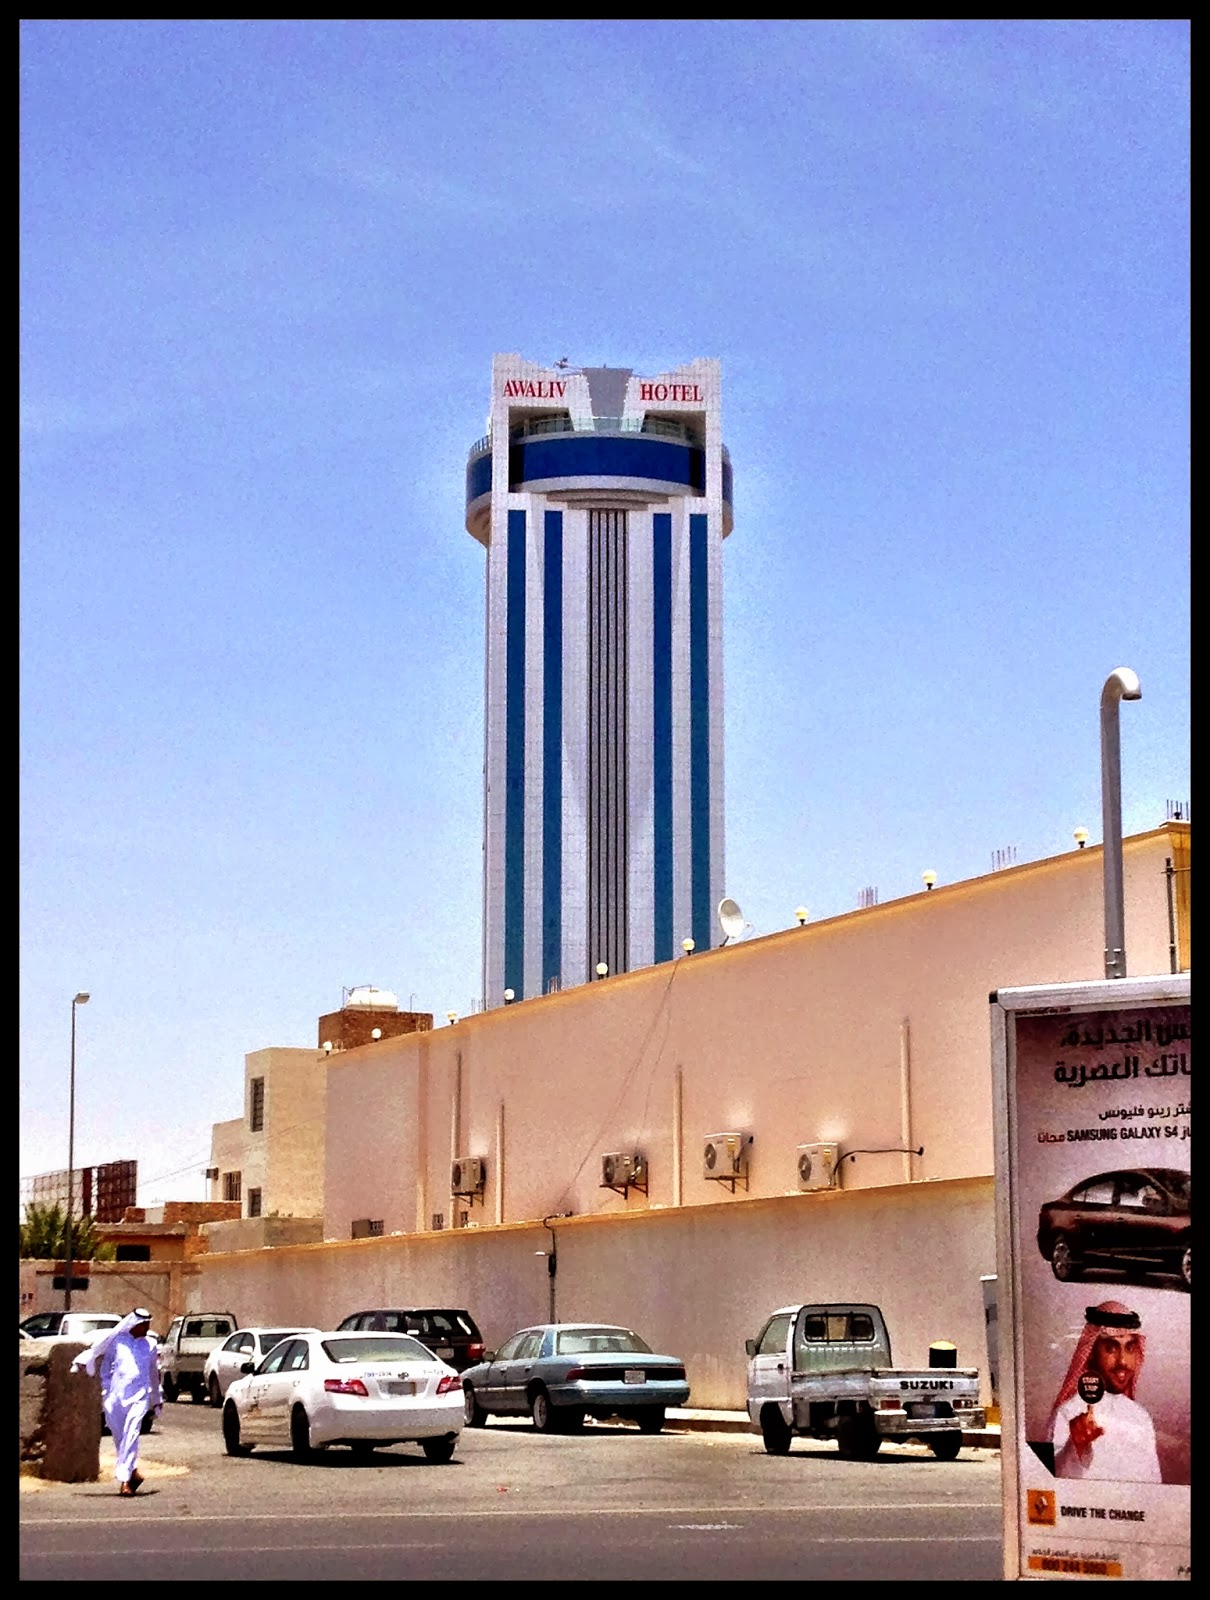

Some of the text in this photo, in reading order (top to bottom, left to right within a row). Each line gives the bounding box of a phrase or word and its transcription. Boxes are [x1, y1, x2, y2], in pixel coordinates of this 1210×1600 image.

[503, 380, 704, 402] AWALIV HOTEL
[1054, 1052, 1191, 1088] اتك العصرية
[1066, 1127, 1118, 1143] SAMSUNG
[1120, 1126, 1162, 1140] GALAXY
[1164, 1125, 1178, 1138] S4
[900, 1380, 954, 1390] SUZUKI
[1060, 1505, 1145, 1522] DRIVE THE CHANGE
